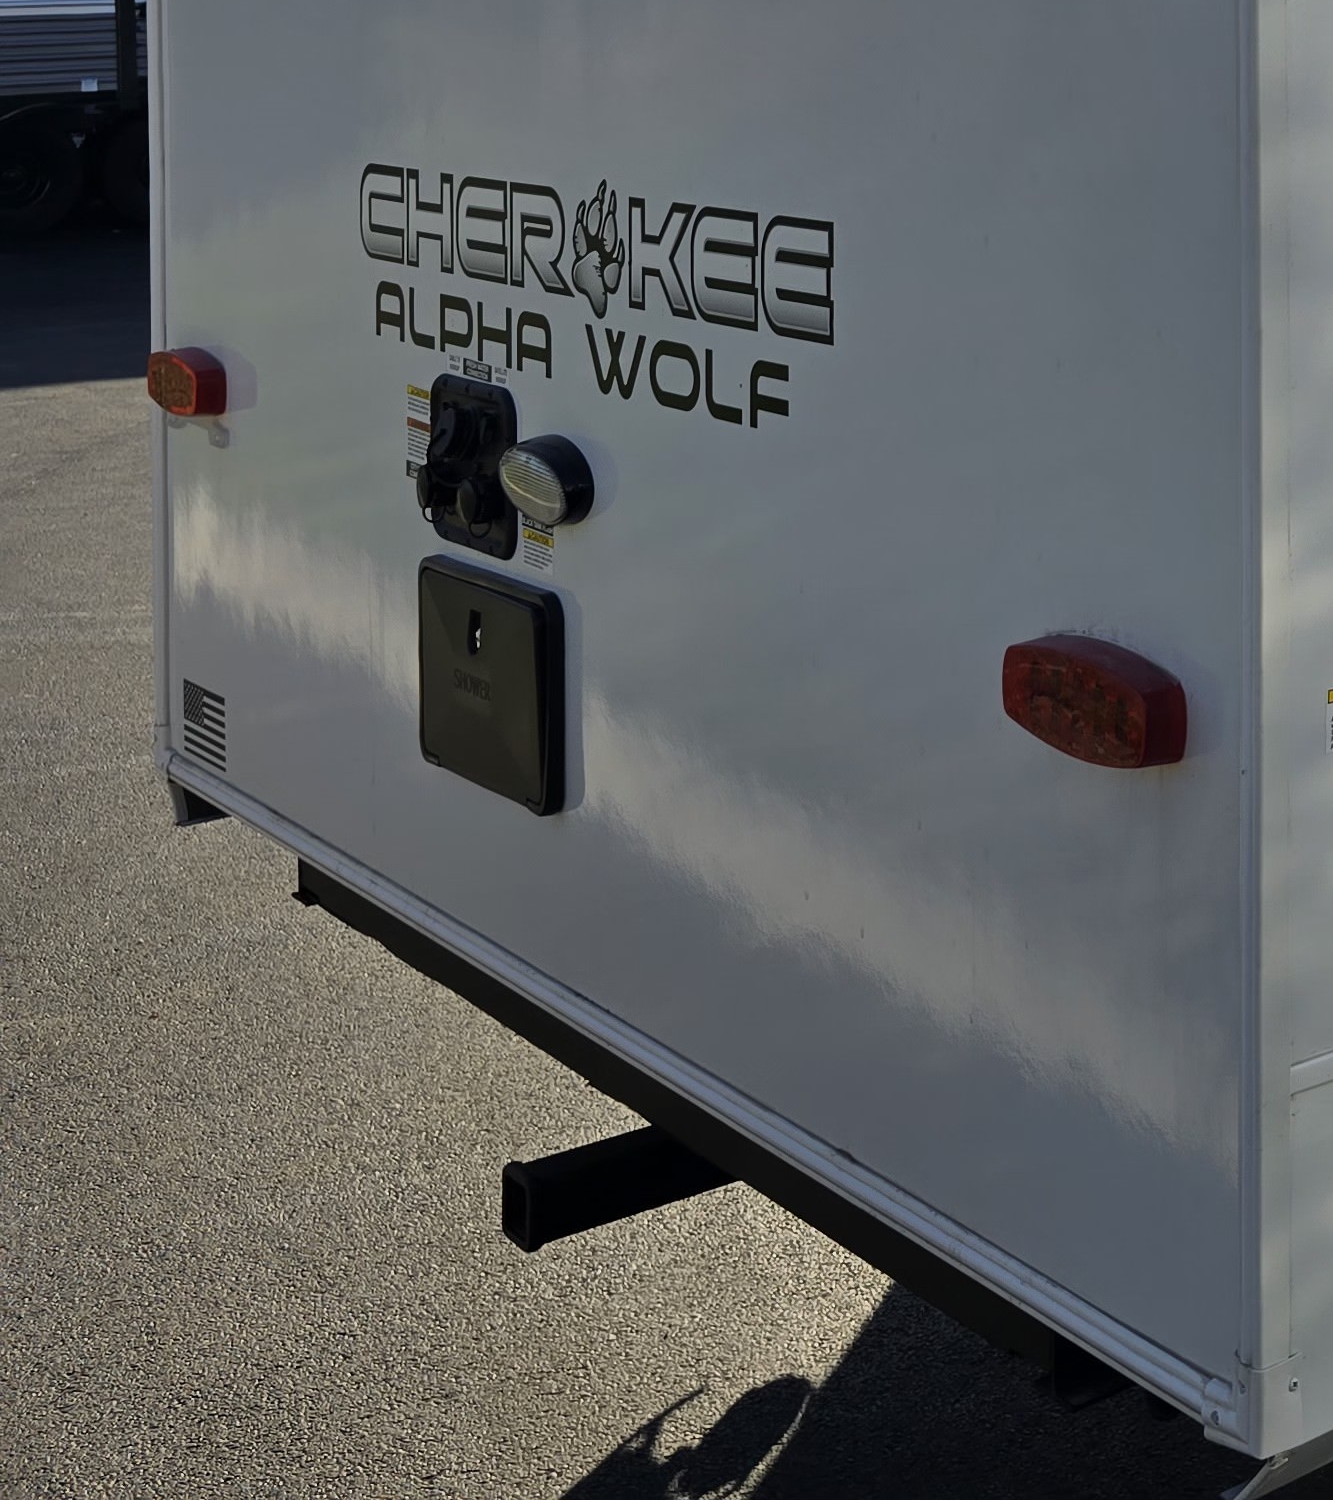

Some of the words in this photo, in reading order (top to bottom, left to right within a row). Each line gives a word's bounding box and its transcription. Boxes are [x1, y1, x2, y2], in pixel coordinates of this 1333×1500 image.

[375, 281, 552, 379] ALPHA
[586, 323, 790, 429] WOLF
[453, 668, 494, 702] SHOWER
